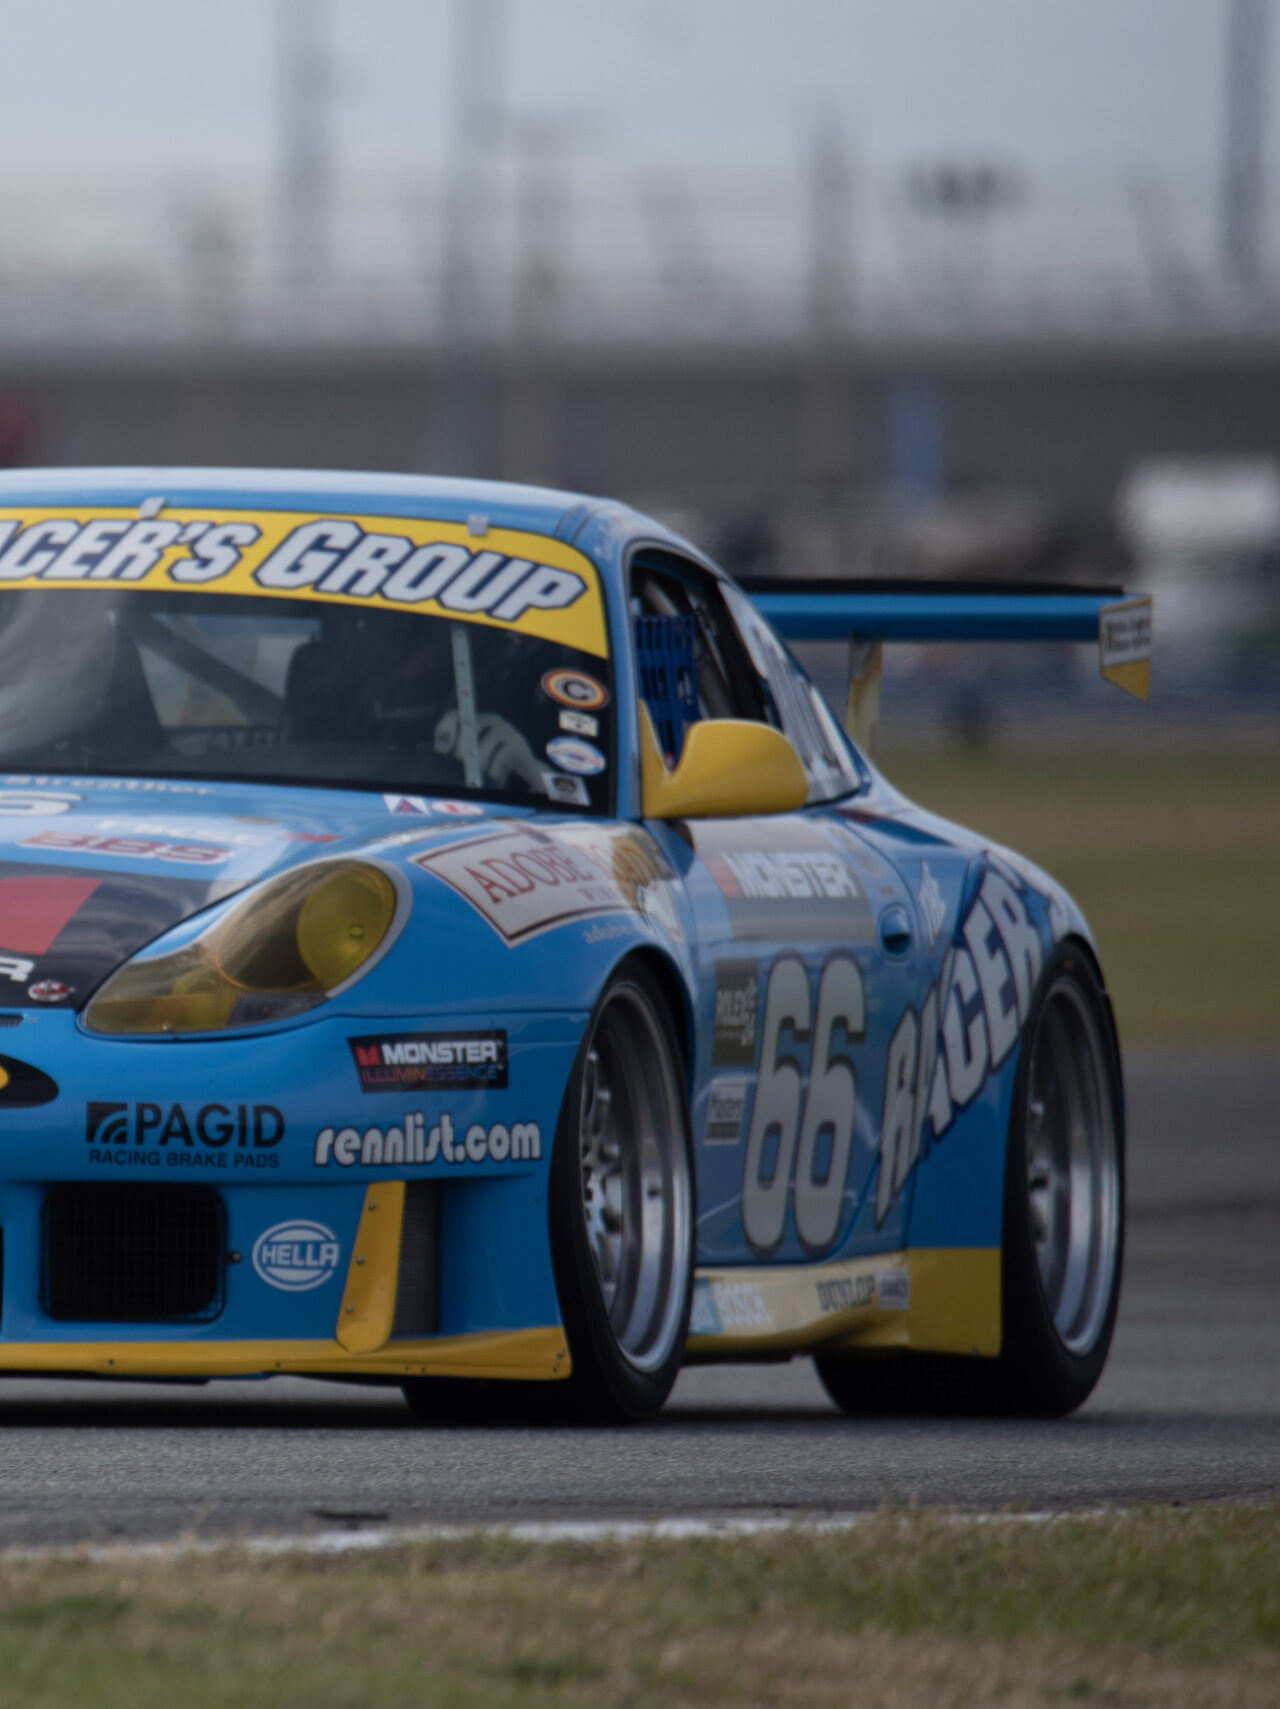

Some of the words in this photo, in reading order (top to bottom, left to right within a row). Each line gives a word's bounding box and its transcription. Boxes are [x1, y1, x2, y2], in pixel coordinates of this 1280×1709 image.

[253, 518, 588, 622] GROUP
[17, 830, 235, 865] BBS
[463, 845, 594, 904] ADOBE
[720, 851, 859, 898] MONSTER
[383, 1040, 498, 1065] MONSTER
[134, 1102, 284, 1148] PAGID
[740, 947, 867, 1259] 66
[88, 1150, 160, 1167] RACING
[166, 1151, 229, 1168] BRAKE
[233, 1152, 279, 1168] PADS
[313, 1111, 542, 1168] rennlist.com
[261, 1242, 339, 1267] HELLA
